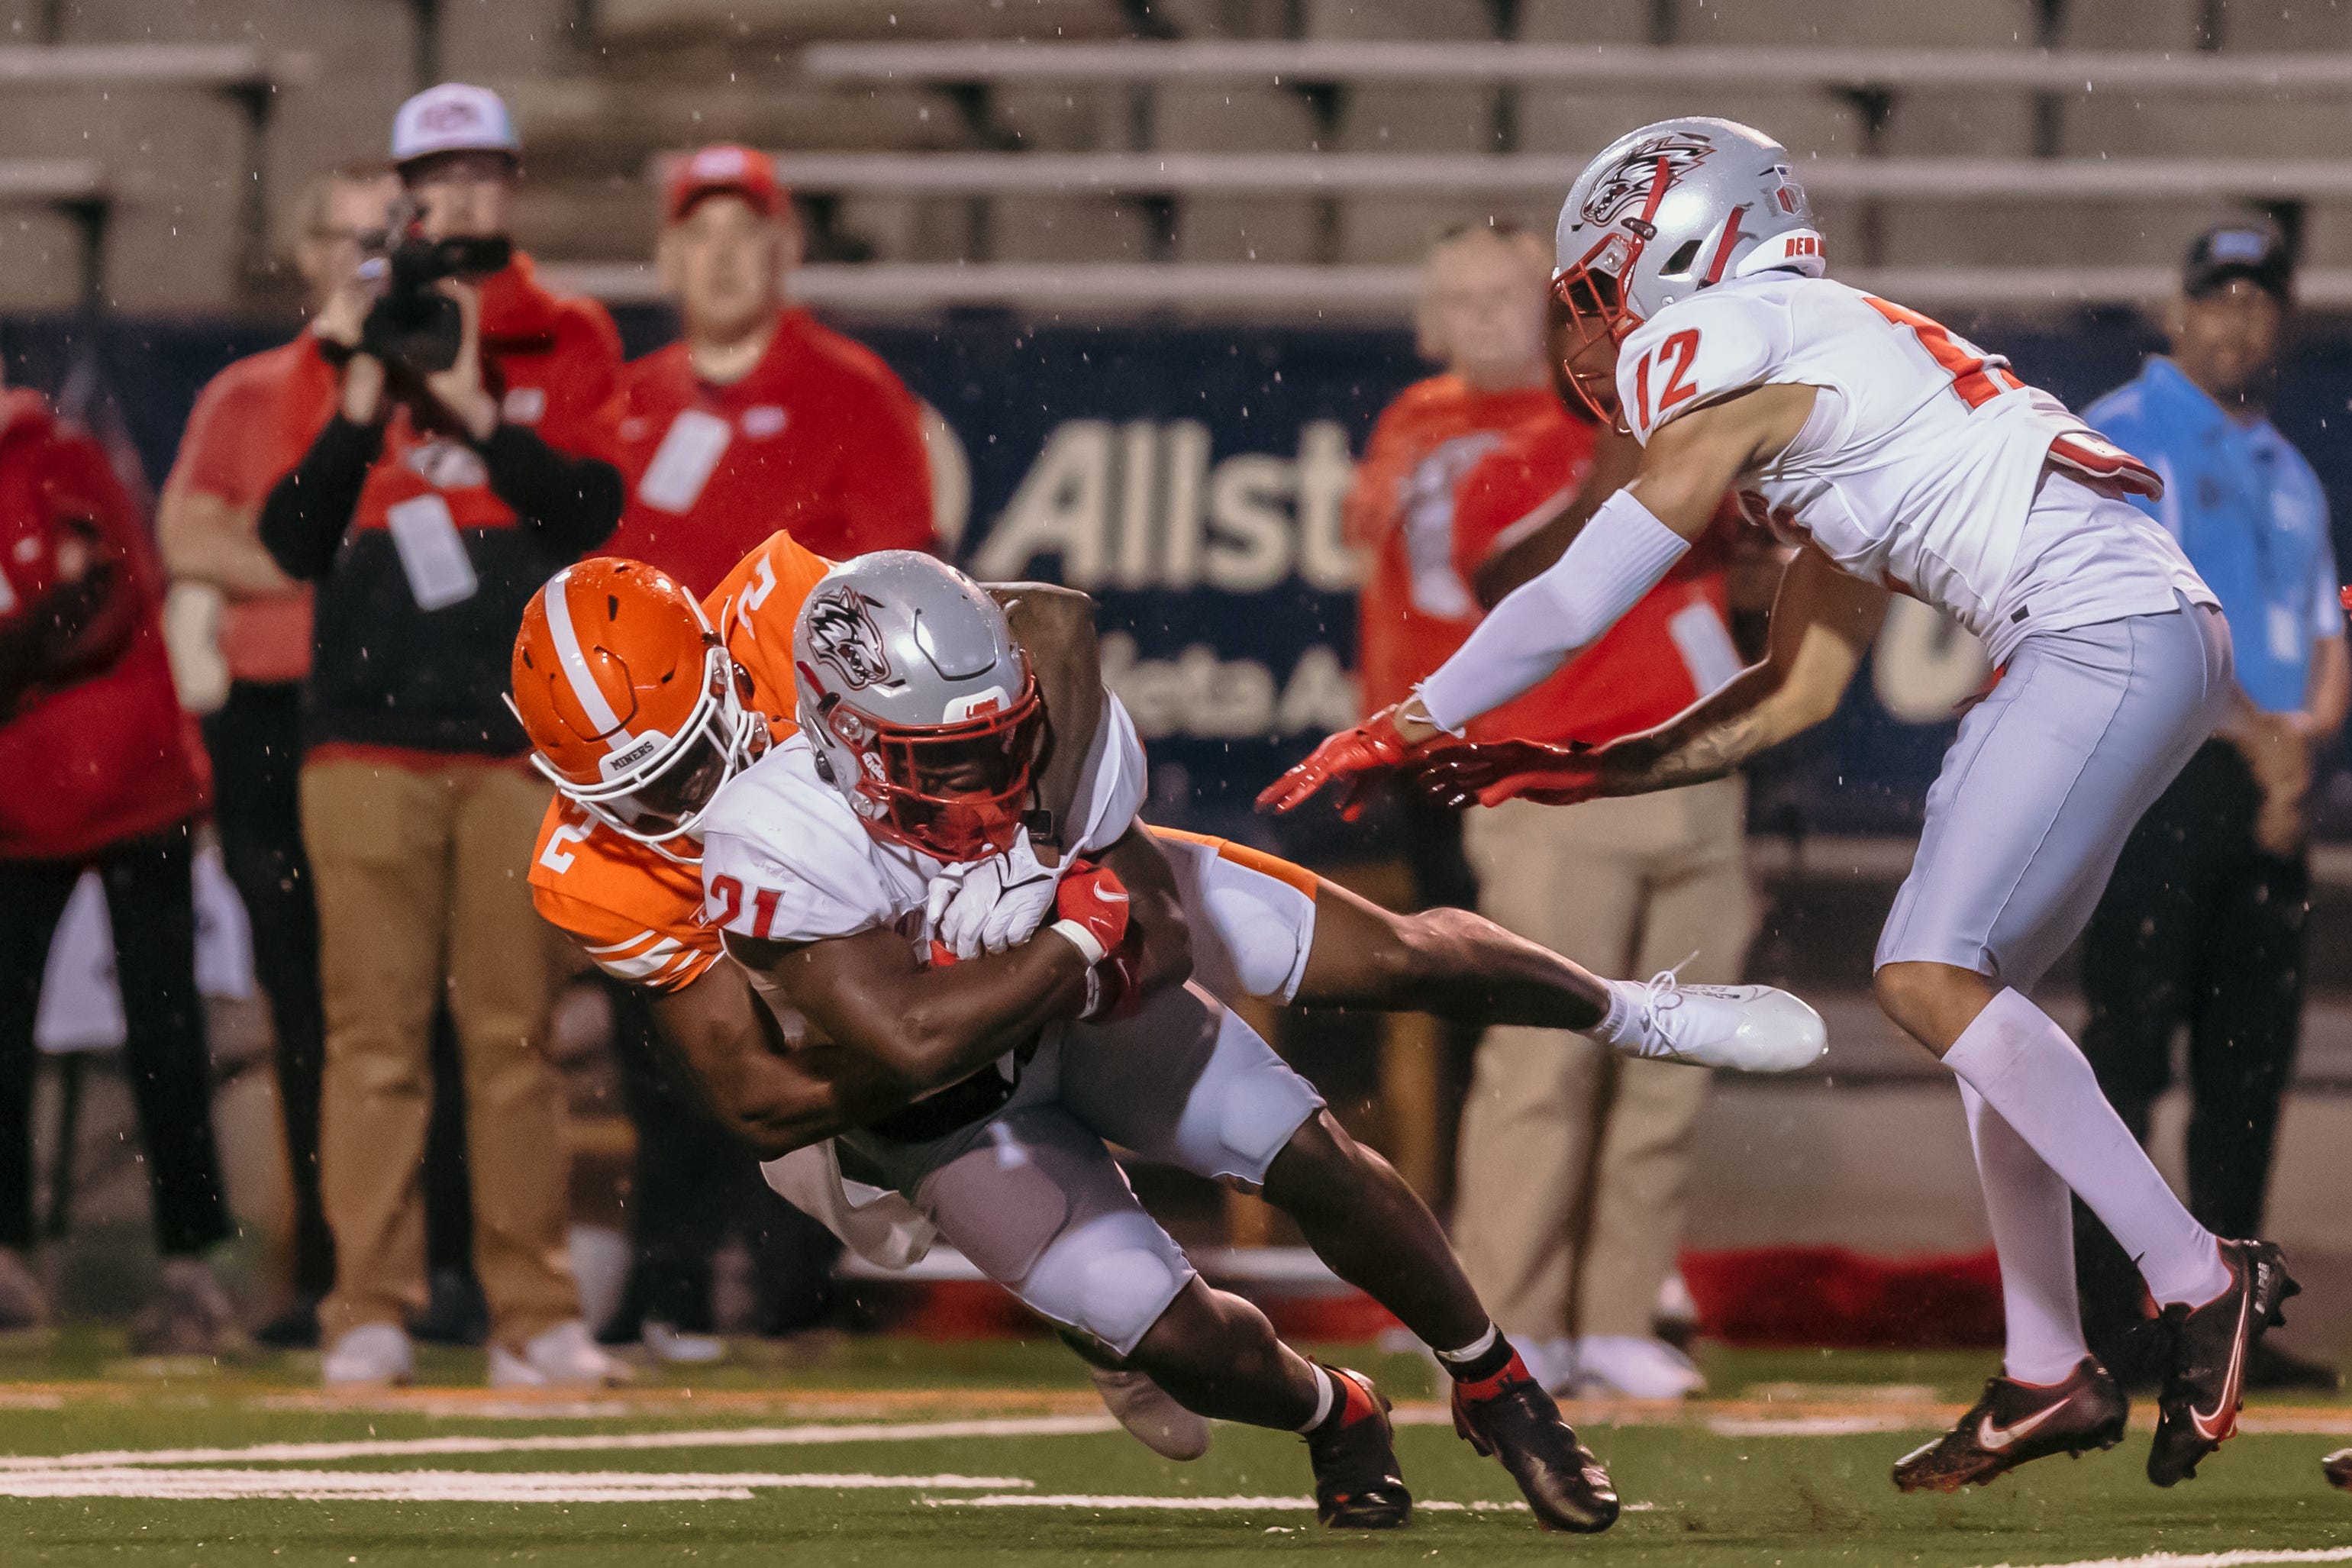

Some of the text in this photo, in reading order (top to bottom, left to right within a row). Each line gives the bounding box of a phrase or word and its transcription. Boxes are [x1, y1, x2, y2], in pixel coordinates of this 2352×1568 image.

[1635, 327, 1702, 434] 12
[971, 418, 1365, 592] Allst
[736, 551, 777, 640] 2
[610, 740, 654, 771] MINERS
[538, 802, 600, 875] 2
[710, 872, 786, 940] 21
